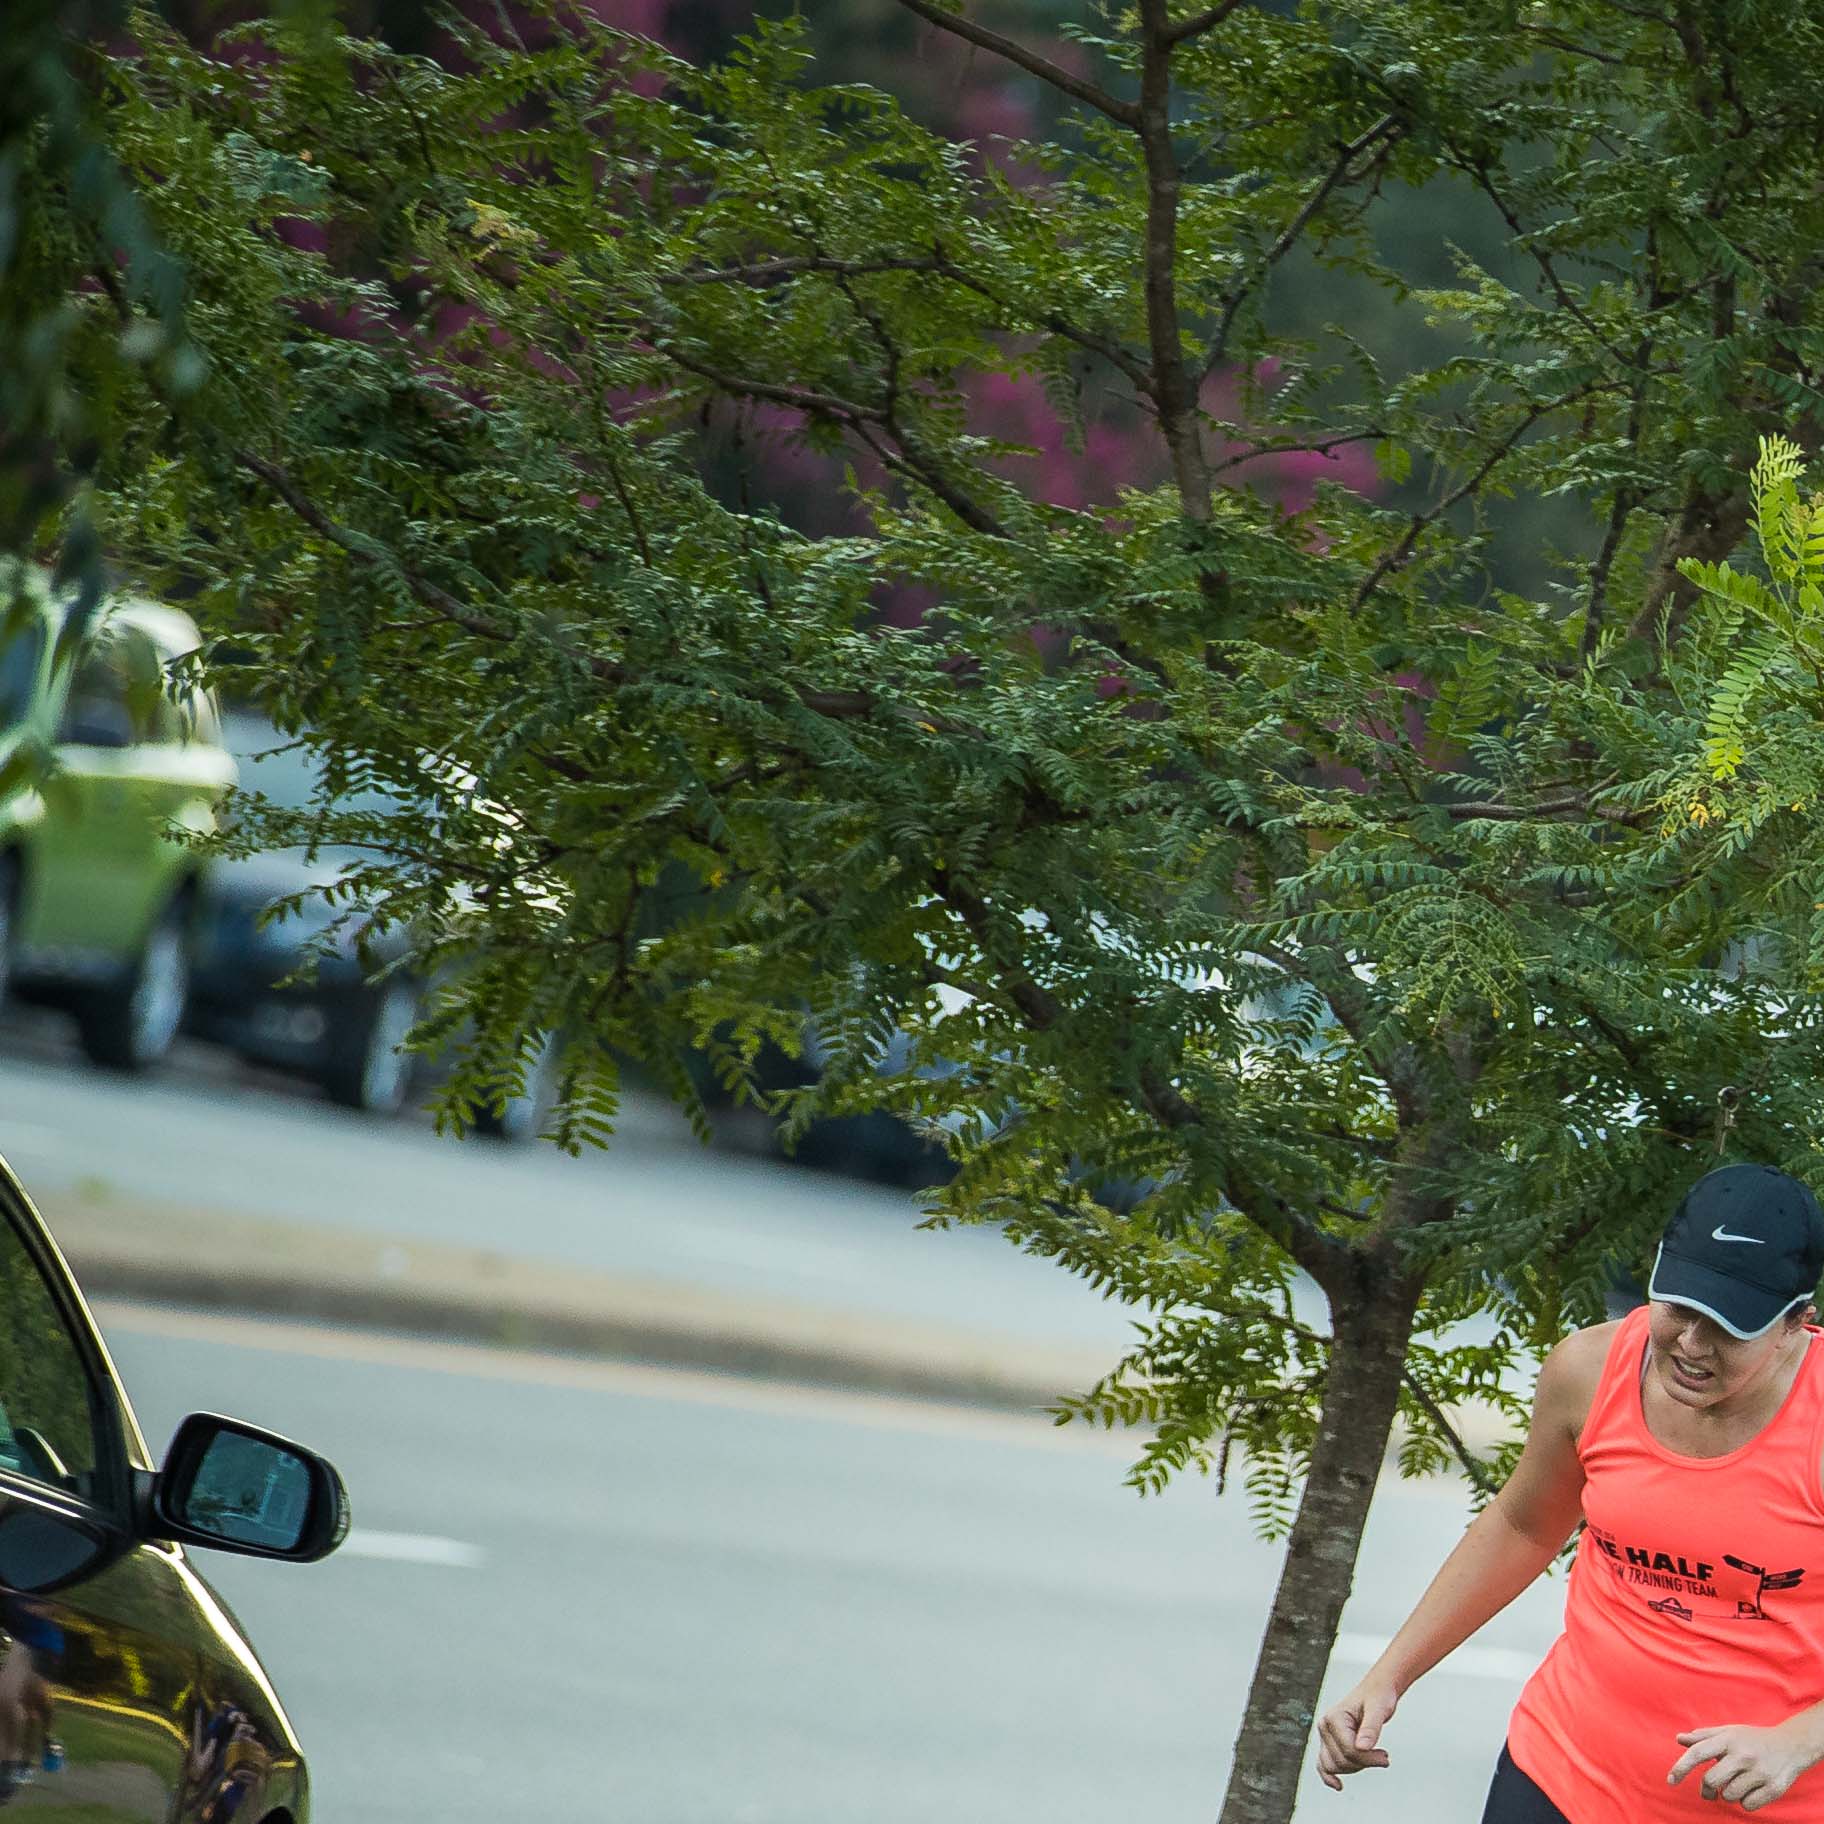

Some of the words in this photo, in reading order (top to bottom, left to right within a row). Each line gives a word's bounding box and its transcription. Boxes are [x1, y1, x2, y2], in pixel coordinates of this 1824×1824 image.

[1625, 1546, 1715, 1582] HALF
[1628, 1566, 1683, 1593] TRAINING
[1685, 1580, 1719, 1599] TEAM
